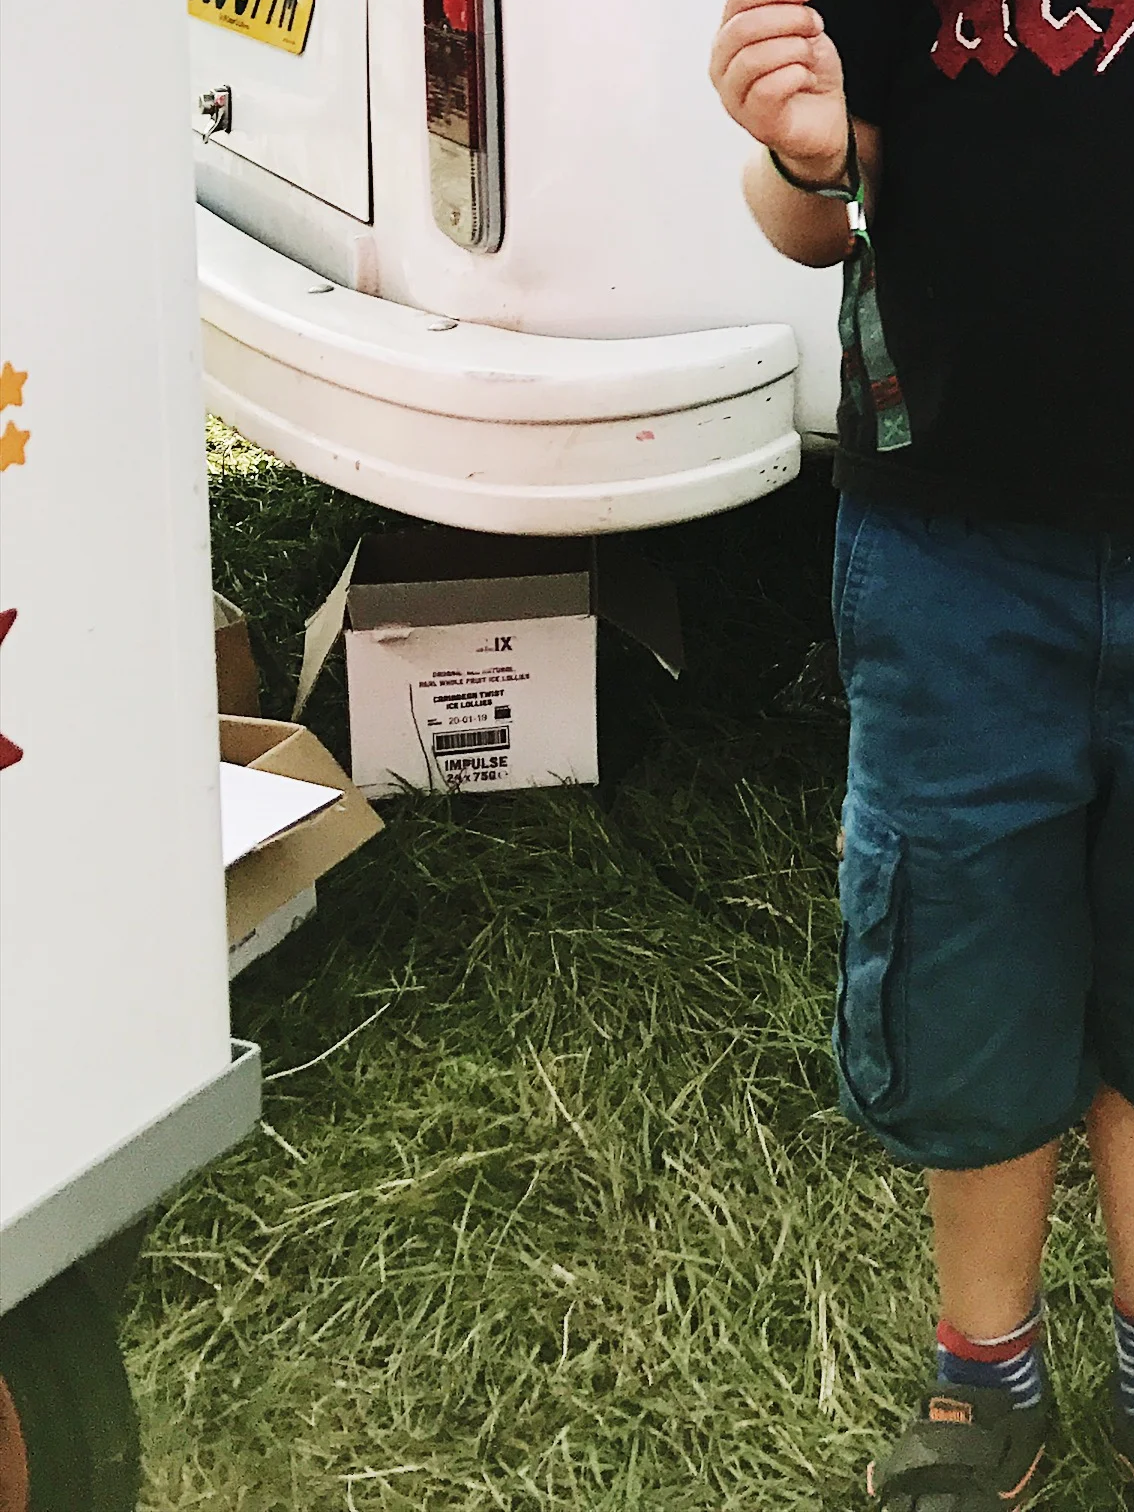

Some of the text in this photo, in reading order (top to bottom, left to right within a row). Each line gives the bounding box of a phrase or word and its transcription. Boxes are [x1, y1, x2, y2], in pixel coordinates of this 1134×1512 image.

[479, 689, 505, 699] TWIST
[446, 699, 493, 710] ICE LOLLIES
[444, 755, 508, 771] IMPULSE
